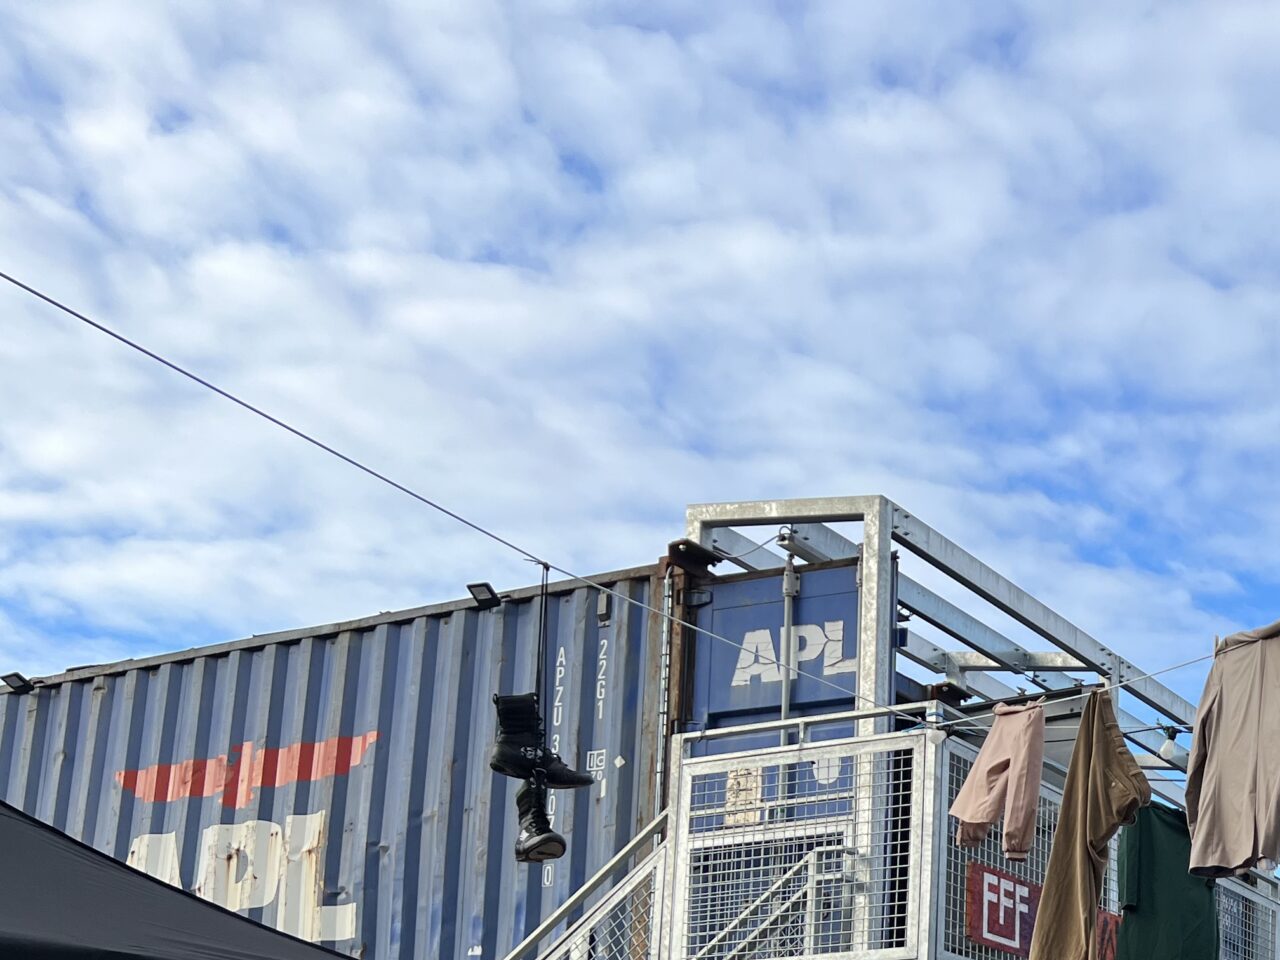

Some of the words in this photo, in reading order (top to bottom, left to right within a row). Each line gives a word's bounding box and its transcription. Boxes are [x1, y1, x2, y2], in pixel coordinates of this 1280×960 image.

[553, 646, 566, 726] APZU
[595, 639, 608, 720] 22G1
[731, 620, 857, 687] APL
